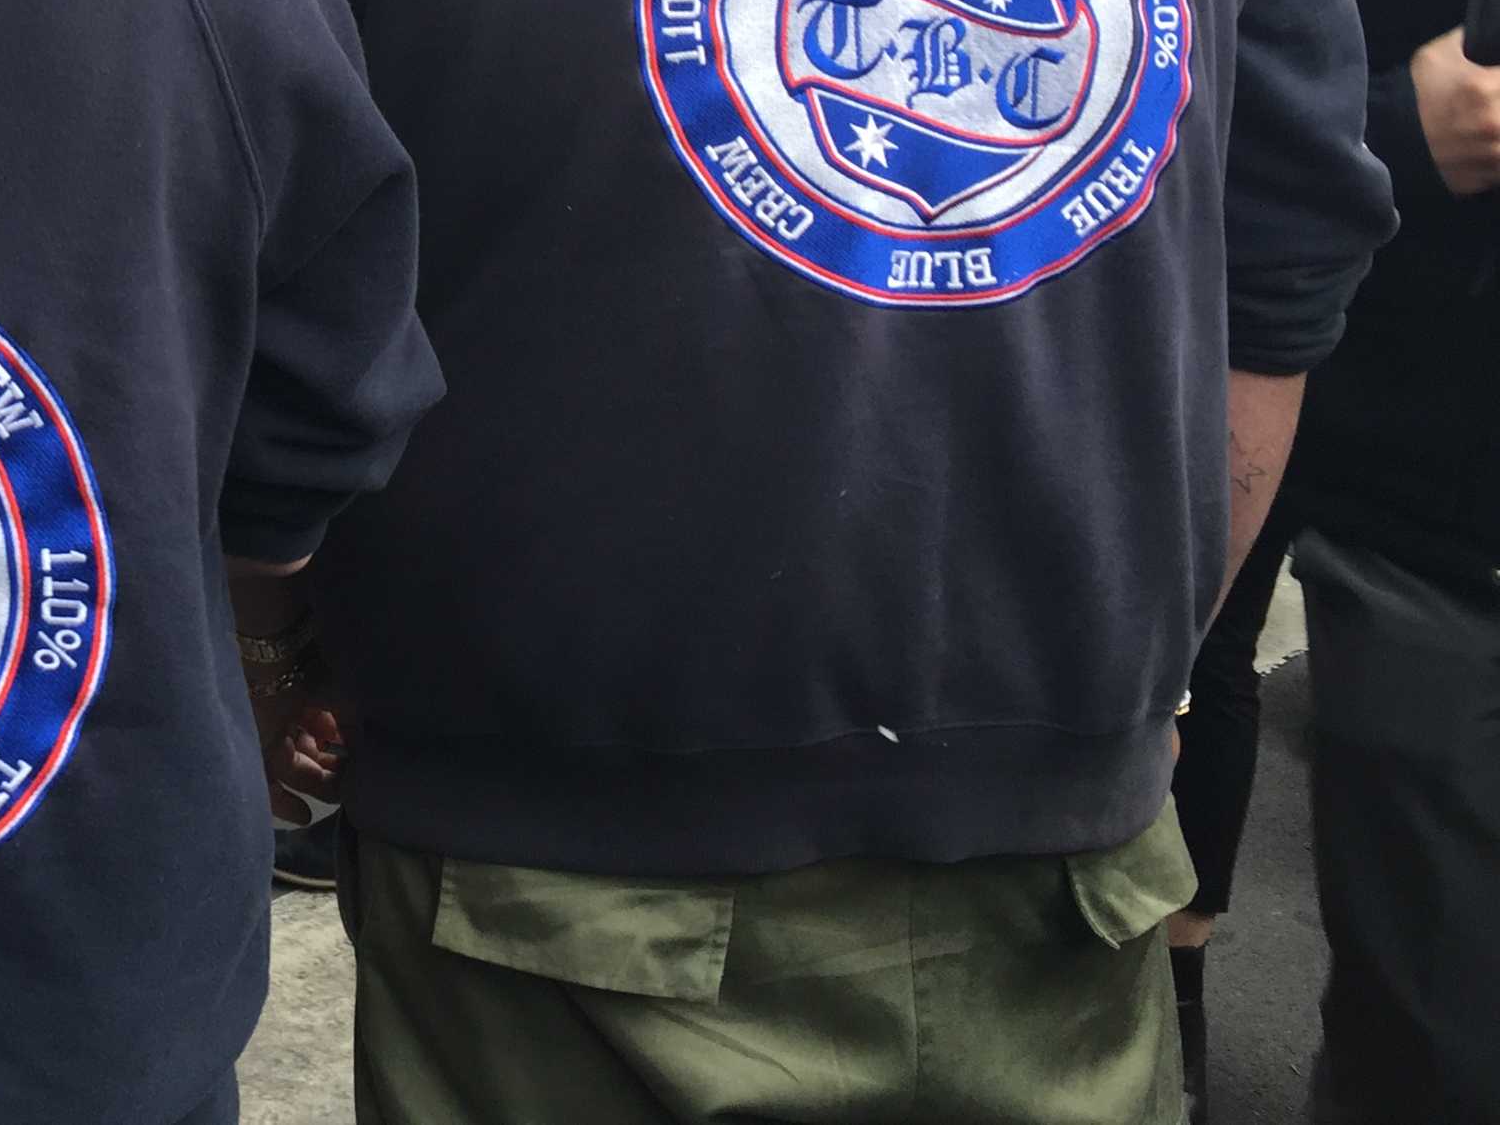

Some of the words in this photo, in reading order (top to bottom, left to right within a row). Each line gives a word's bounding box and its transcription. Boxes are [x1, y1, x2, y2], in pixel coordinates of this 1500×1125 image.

[704, 136, 815, 241] CREW
[1061, 137, 1154, 239] TRUE
[887, 247, 998, 289] BLUE
[33, 547, 87, 672] 110%
